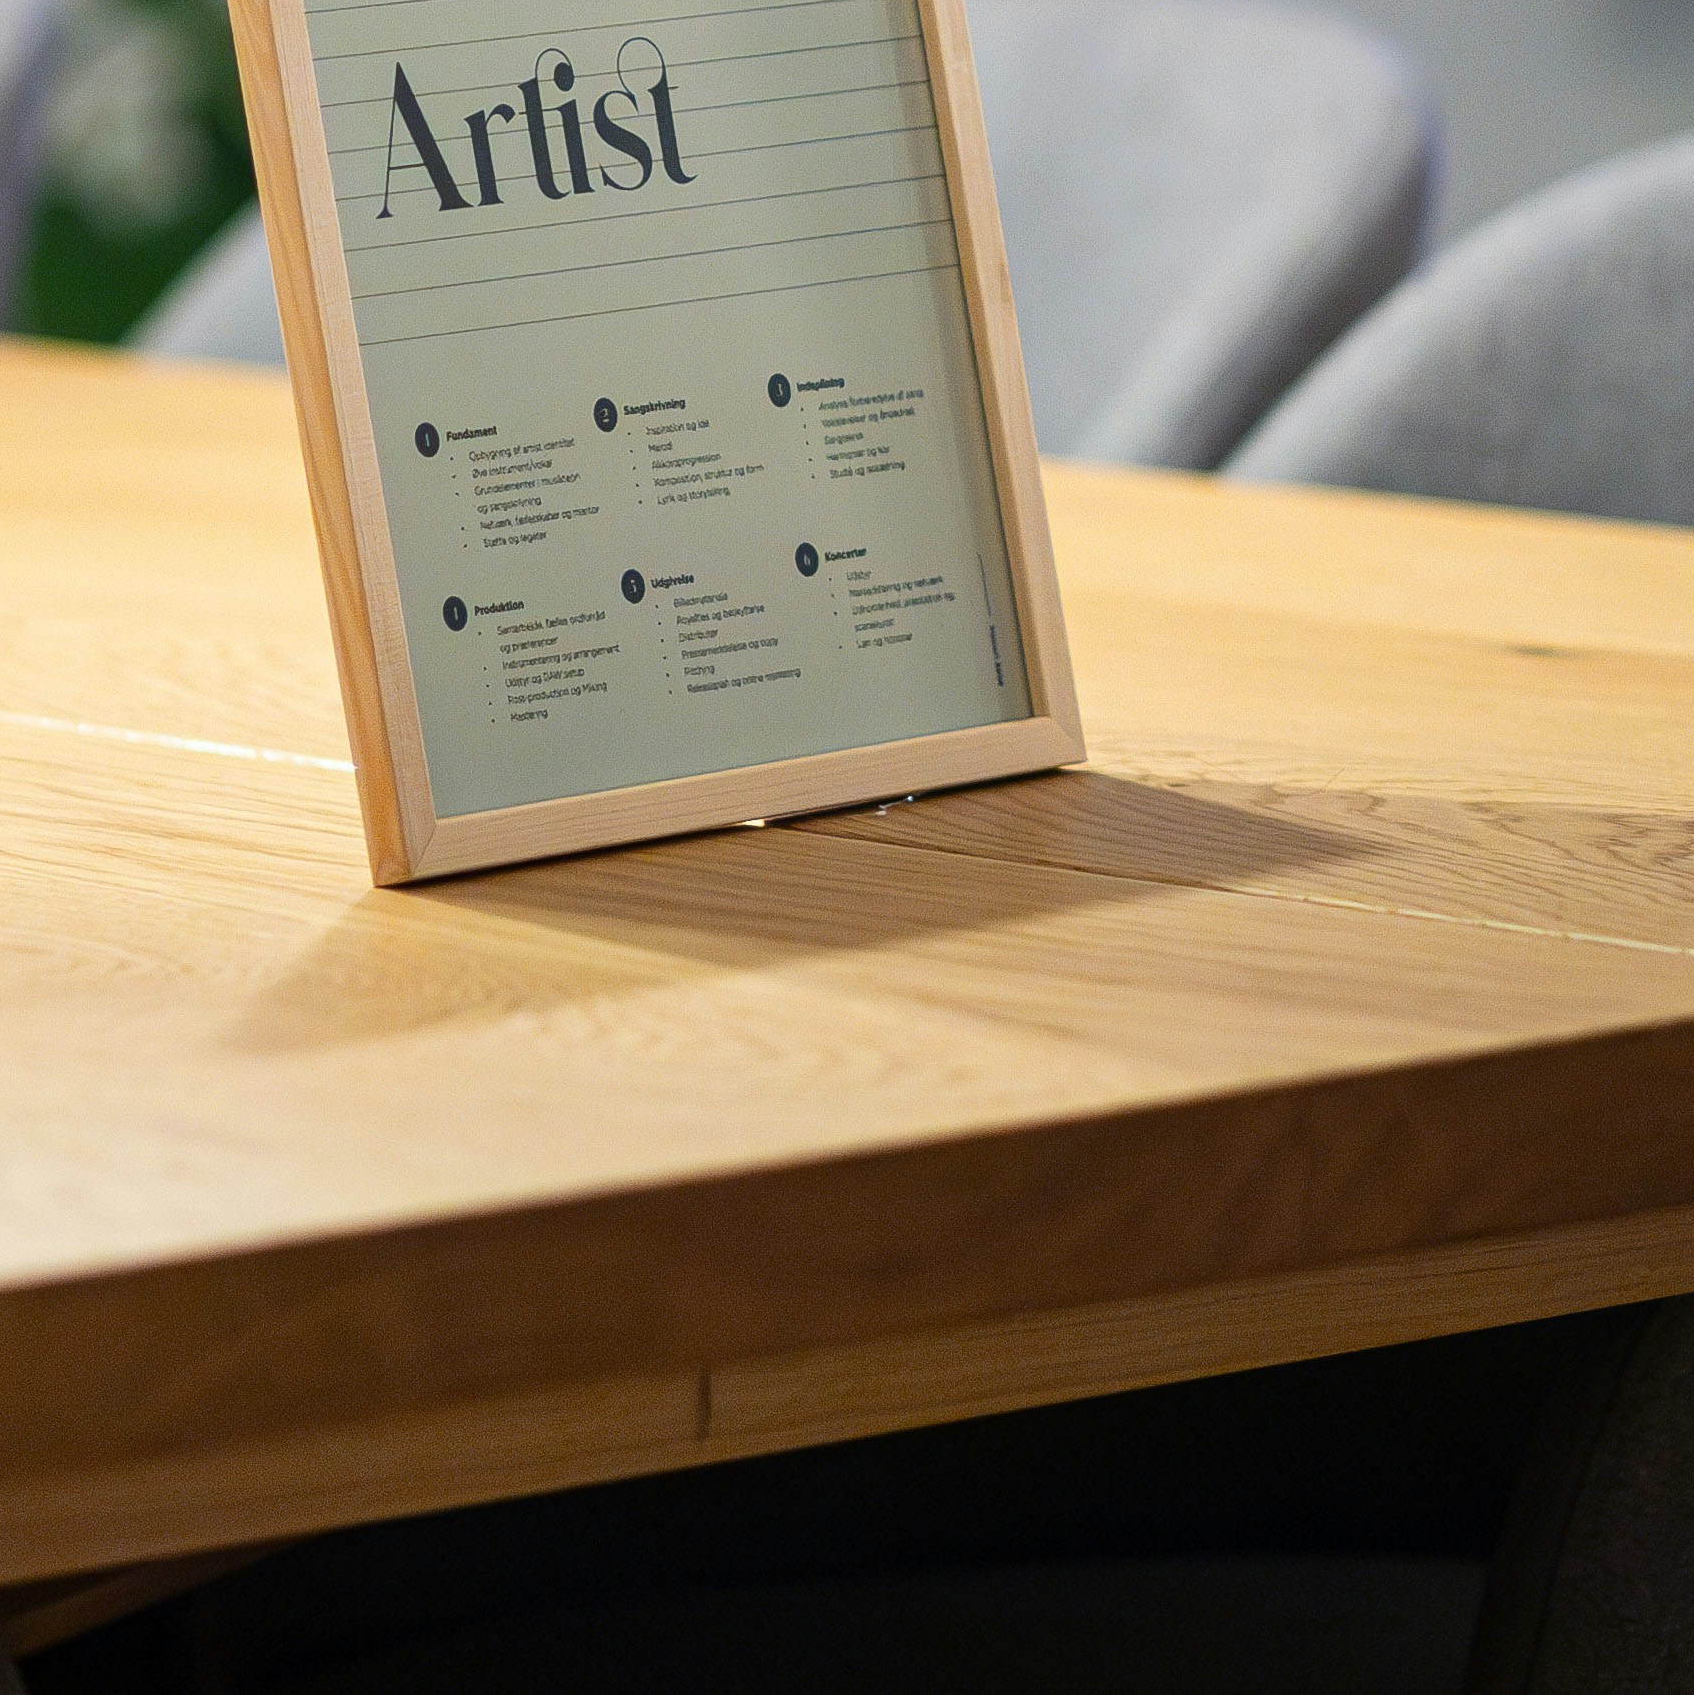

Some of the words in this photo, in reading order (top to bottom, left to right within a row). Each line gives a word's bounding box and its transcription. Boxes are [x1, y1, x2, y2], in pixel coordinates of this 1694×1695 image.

[376, 34, 700, 219] Artist
[624, 398, 685, 416] Sangskrivning
[446, 426, 498, 442] Fundament
[824, 548, 867, 562] Koncerter
[651, 574, 695, 589] Udgivelse
[474, 600, 524, 616] Produktion
